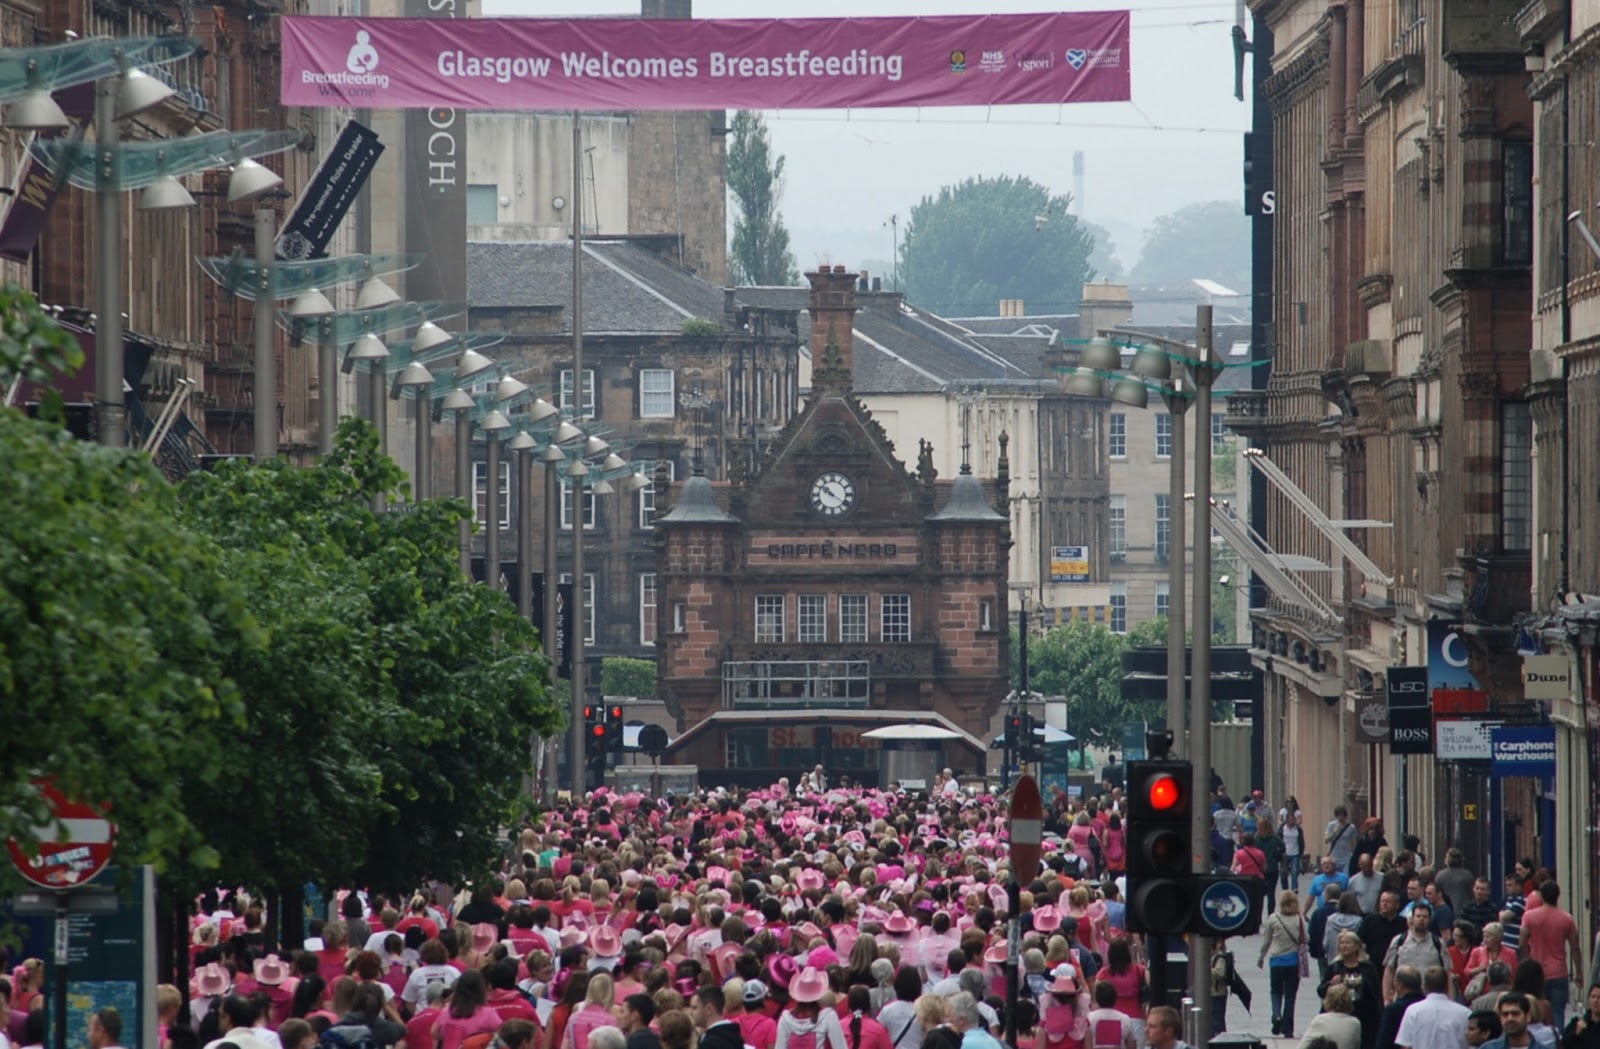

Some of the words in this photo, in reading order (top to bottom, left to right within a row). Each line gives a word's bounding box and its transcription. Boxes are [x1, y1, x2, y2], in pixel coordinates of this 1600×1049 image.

[982, 51, 1004, 60] NHS
[438, 51, 551, 82] Glasgow
[561, 52, 698, 77] Welcomes
[709, 50, 902, 80] Breastfeeding
[302, 70, 389, 88] Breastfeeding
[318, 84, 377, 97] Wecome
[303, 184, 334, 228] Pre-owned
[329, 160, 348, 185] Rolex
[345, 133, 365, 161] Dealer
[838, 544, 896, 556] NERO
[1526, 672, 1568, 682] Dune
[1394, 728, 1429, 739] BOSS
[1500, 741, 1554, 752] Carphone
[1494, 751, 1554, 761] Warehouse
